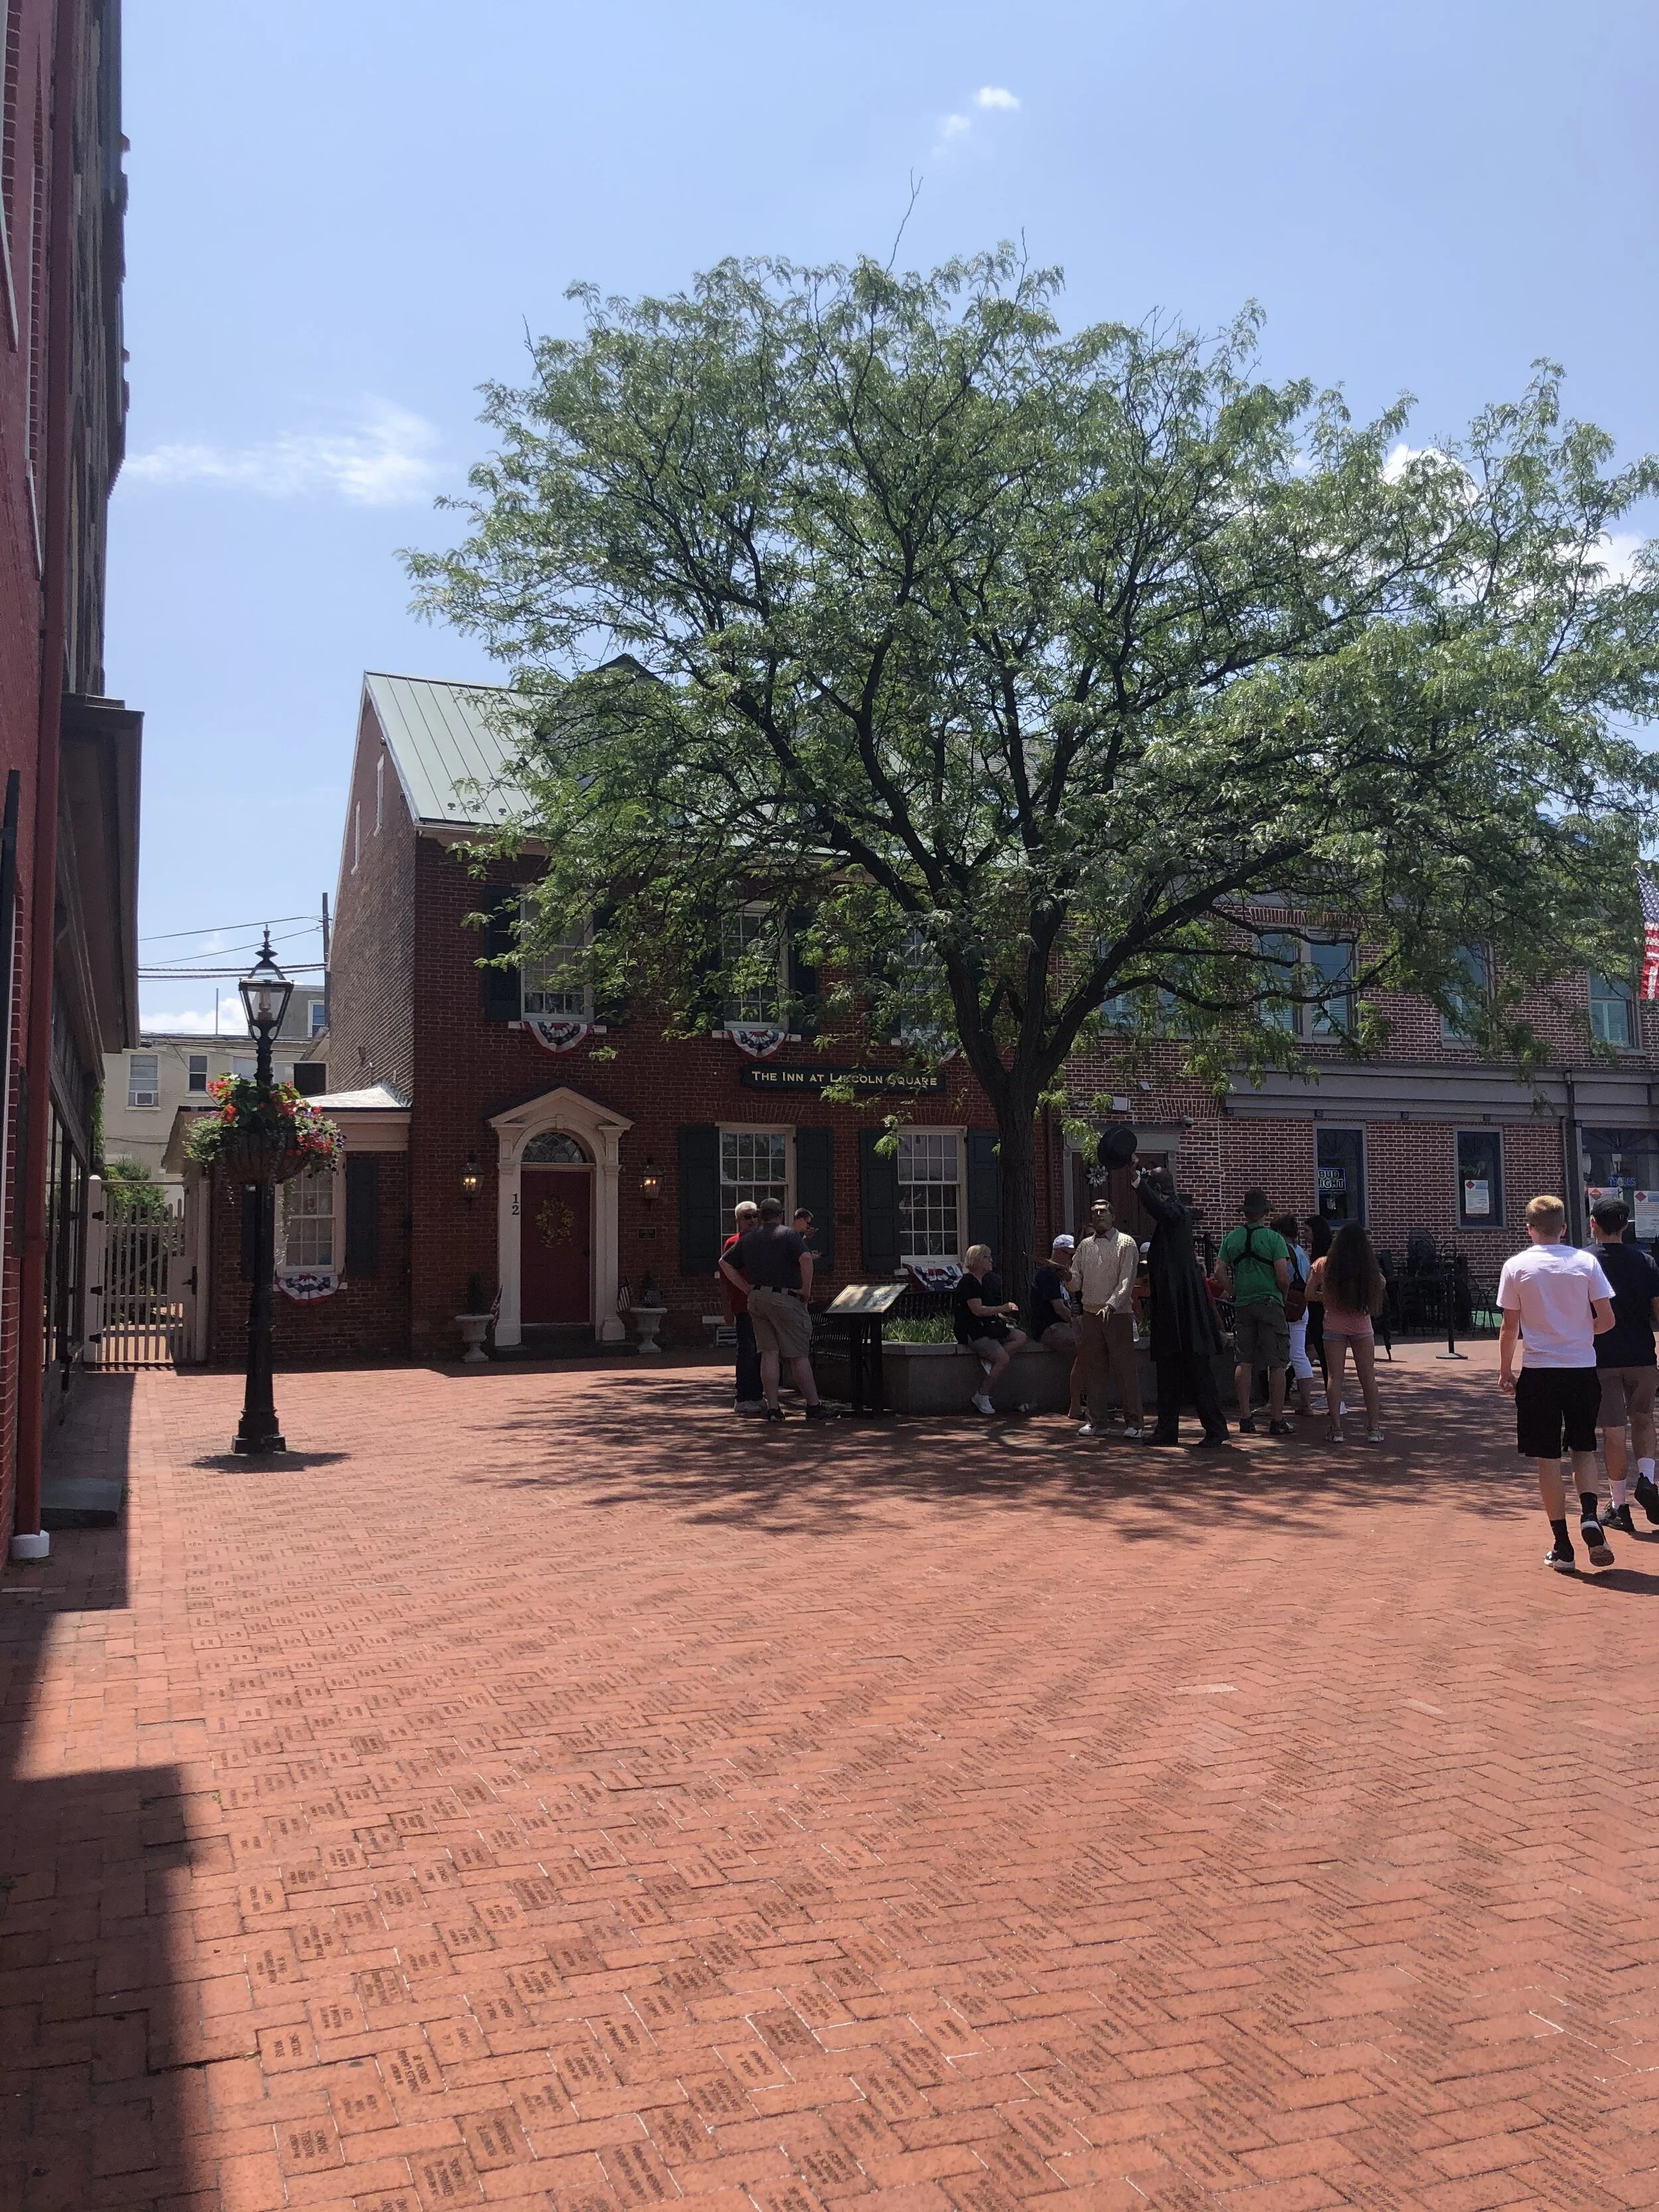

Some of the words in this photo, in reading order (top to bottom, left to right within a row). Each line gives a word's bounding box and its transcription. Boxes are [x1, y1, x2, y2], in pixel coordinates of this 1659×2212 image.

[751, 1070, 778, 1081] THE
[782, 1071, 804, 1082] INN
[810, 1074, 824, 1082] AT
[830, 1073, 883, 1084] LCOLN
[1318, 1169, 1339, 1179] BUD
[512, 1193, 520, 1215] 12
[605, 2026, 630, 2053] JOSEPHINE
[620, 2023, 642, 2045] CURRAN
[273, 2039, 285, 2058] SYLVIA
[289, 2034, 303, 2057] COLLINS
[897, 2040, 932, 2069] ELIZABETH
[738, 2059, 759, 2078] CAROL
[747, 2049, 775, 2076] CHAPMAN
[403, 2070, 421, 2093] CHARLES
[300, 2130, 316, 2158] RUSSELL
